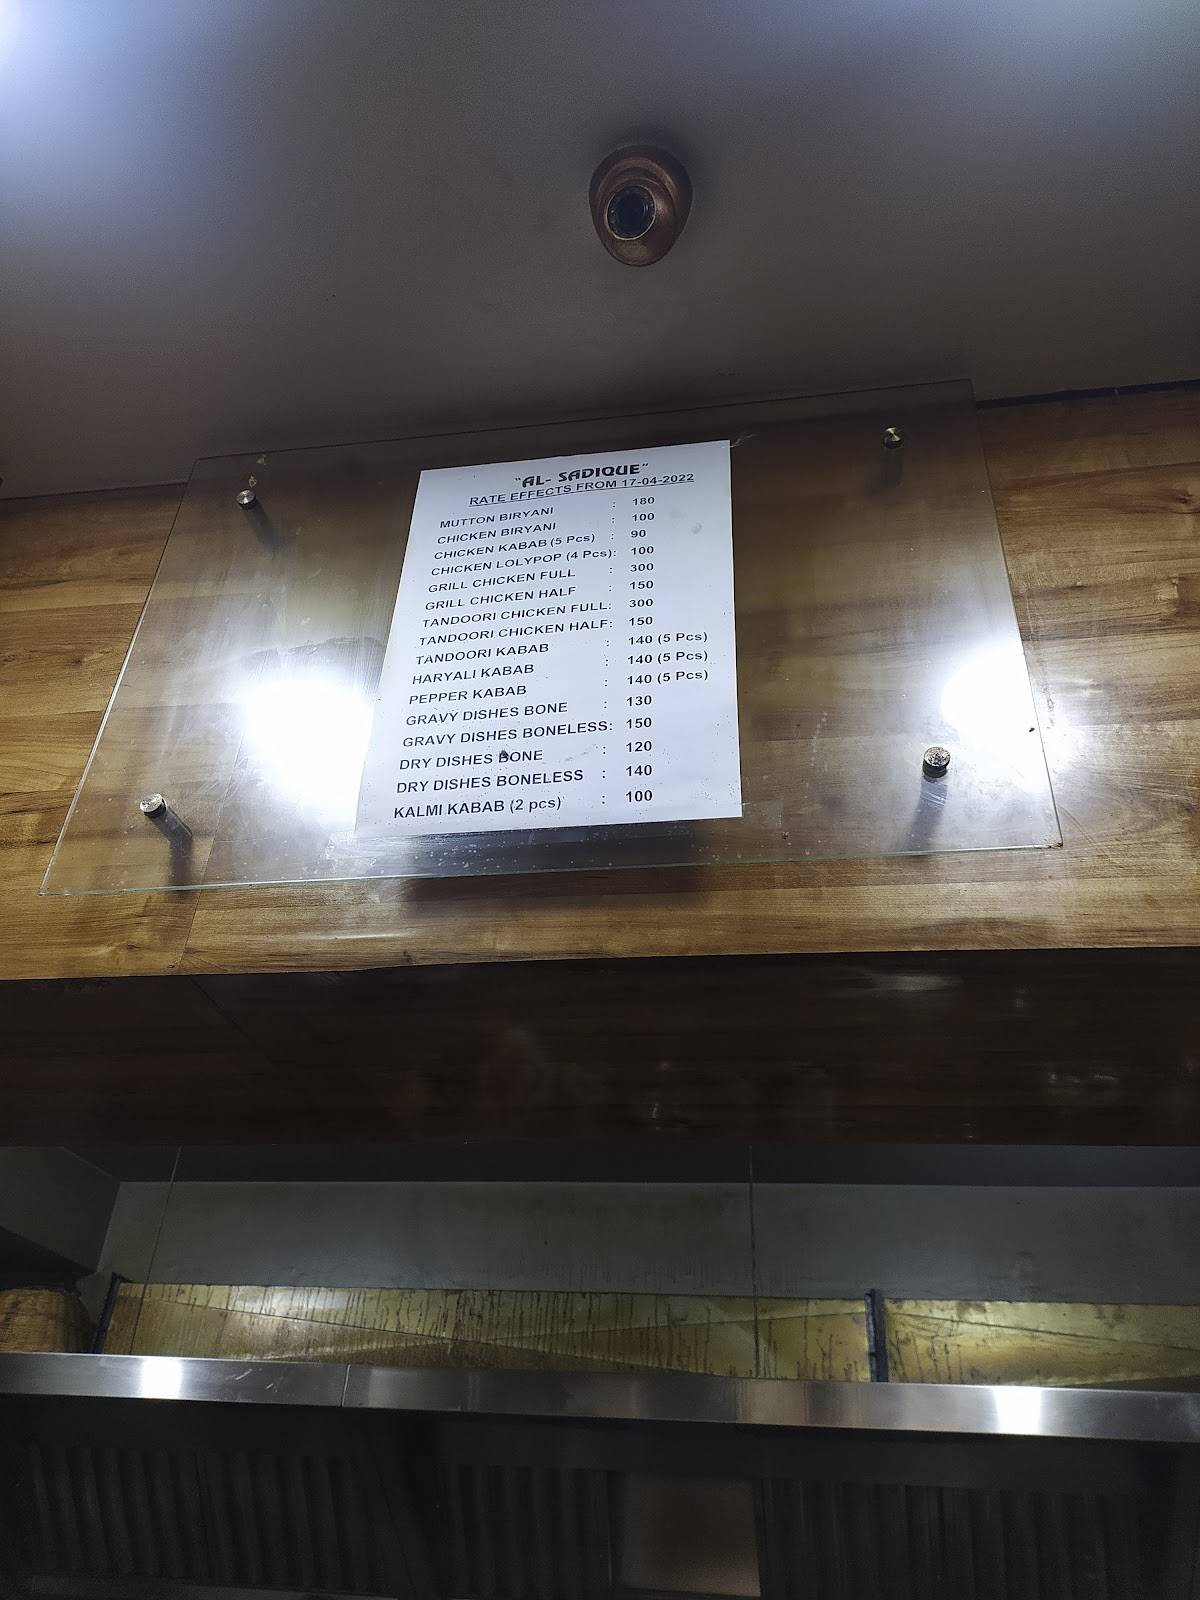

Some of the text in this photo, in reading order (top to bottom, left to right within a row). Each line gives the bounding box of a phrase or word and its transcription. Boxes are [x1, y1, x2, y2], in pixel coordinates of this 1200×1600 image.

[469, 473, 694, 505] RATE EFFECTS FROM 17-04-2022
[439, 515, 495, 528] MUTTON
[499, 507, 554, 521] BIRYANI
[632, 497, 655, 505] 180
[437, 530, 497, 545] CHICKEN
[500, 523, 556, 537] BIRYANI
[632, 512, 655, 521] 100
[434, 545, 494, 560] CHICKEN
[498, 539, 548, 552] KABAB
[550, 537, 563, 548] (5
[566, 532, 595, 545] Pcs)
[631, 529, 646, 538] 90
[431, 561, 492, 576] CHICKEN
[496, 552, 562, 569] LOLYPOP
[566, 551, 579, 562] (4
[631, 546, 654, 554] 100
[428, 581, 468, 592] GRILL
[472, 572, 536, 588] CHICKEN
[540, 568, 576, 580] FULL
[630, 562, 654, 572] 300
[425, 598, 466, 610] GRILL
[470, 589, 534, 606] CHICKEN
[538, 586, 577, 598] HALF
[629, 580, 654, 589] 150
[422, 612, 497, 628] TANDOORI
[500, 605, 566, 621] CHICKEN
[629, 598, 654, 608] 300
[419, 631, 495, 647] TANDOORI
[498, 622, 565, 639] CHICKEN
[628, 616, 653, 626] 150
[415, 648, 492, 665] TANDOORI
[496, 644, 550, 657] KABAB
[628, 634, 653, 645] 140
[658, 633, 671, 644] (5
[676, 631, 708, 643] Pcs)
[412, 669, 477, 685] HARYALI
[480, 664, 535, 678] KABAB
[627, 654, 653, 665] 140
[657, 652, 671, 664] (5
[676, 650, 708, 663] Pcs)
[409, 689, 468, 705] PEPPER
[472, 685, 527, 699] KABAB
[627, 674, 653, 685] 140
[657, 672, 671, 684] (5
[676, 669, 709, 682] Pcs)
[406, 712, 458, 726] GRAVY
[462, 707, 520, 721] DISHES
[523, 702, 568, 716] BONE
[626, 695, 652, 706] 130
[403, 733, 456, 748] GRAVY
[460, 728, 518, 743] DISHES
[626, 717, 652, 729] 150
[399, 757, 432, 770] DRY
[436, 753, 494, 768] DISHES
[498, 750, 544, 763] BONE
[626, 740, 652, 752] 120
[396, 780, 429, 794] DRY
[433, 775, 492, 791] DISHES
[496, 769, 584, 786] BONELESS
[626, 764, 653, 776] 140
[393, 804, 444, 819] KALMI
[447, 800, 505, 815] KABAB
[509, 799, 524, 813] (2
[528, 797, 561, 811] pcs)
[625, 790, 653, 802] 100
